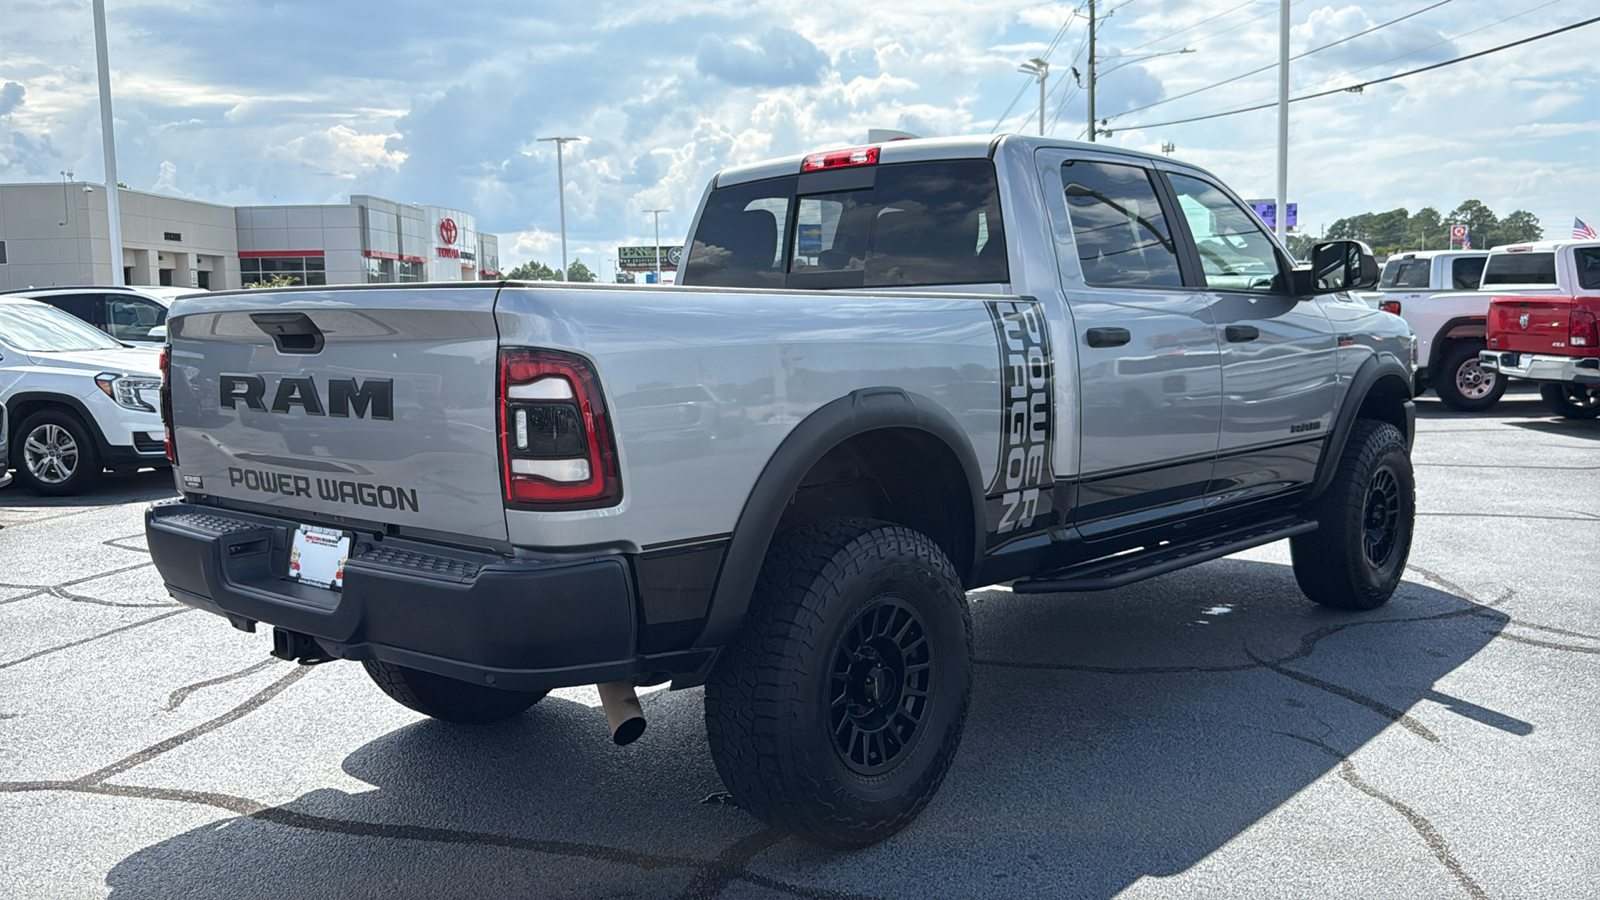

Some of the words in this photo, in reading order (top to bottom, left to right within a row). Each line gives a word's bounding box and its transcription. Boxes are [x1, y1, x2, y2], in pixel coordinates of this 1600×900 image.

[437, 247, 460, 259] TOYOTA
[219, 372, 394, 421] RAM
[997, 303, 1029, 534] WAGON
[1016, 306, 1048, 529] POWER
[228, 467, 312, 499] POWER
[316, 478, 420, 513] WAGON
